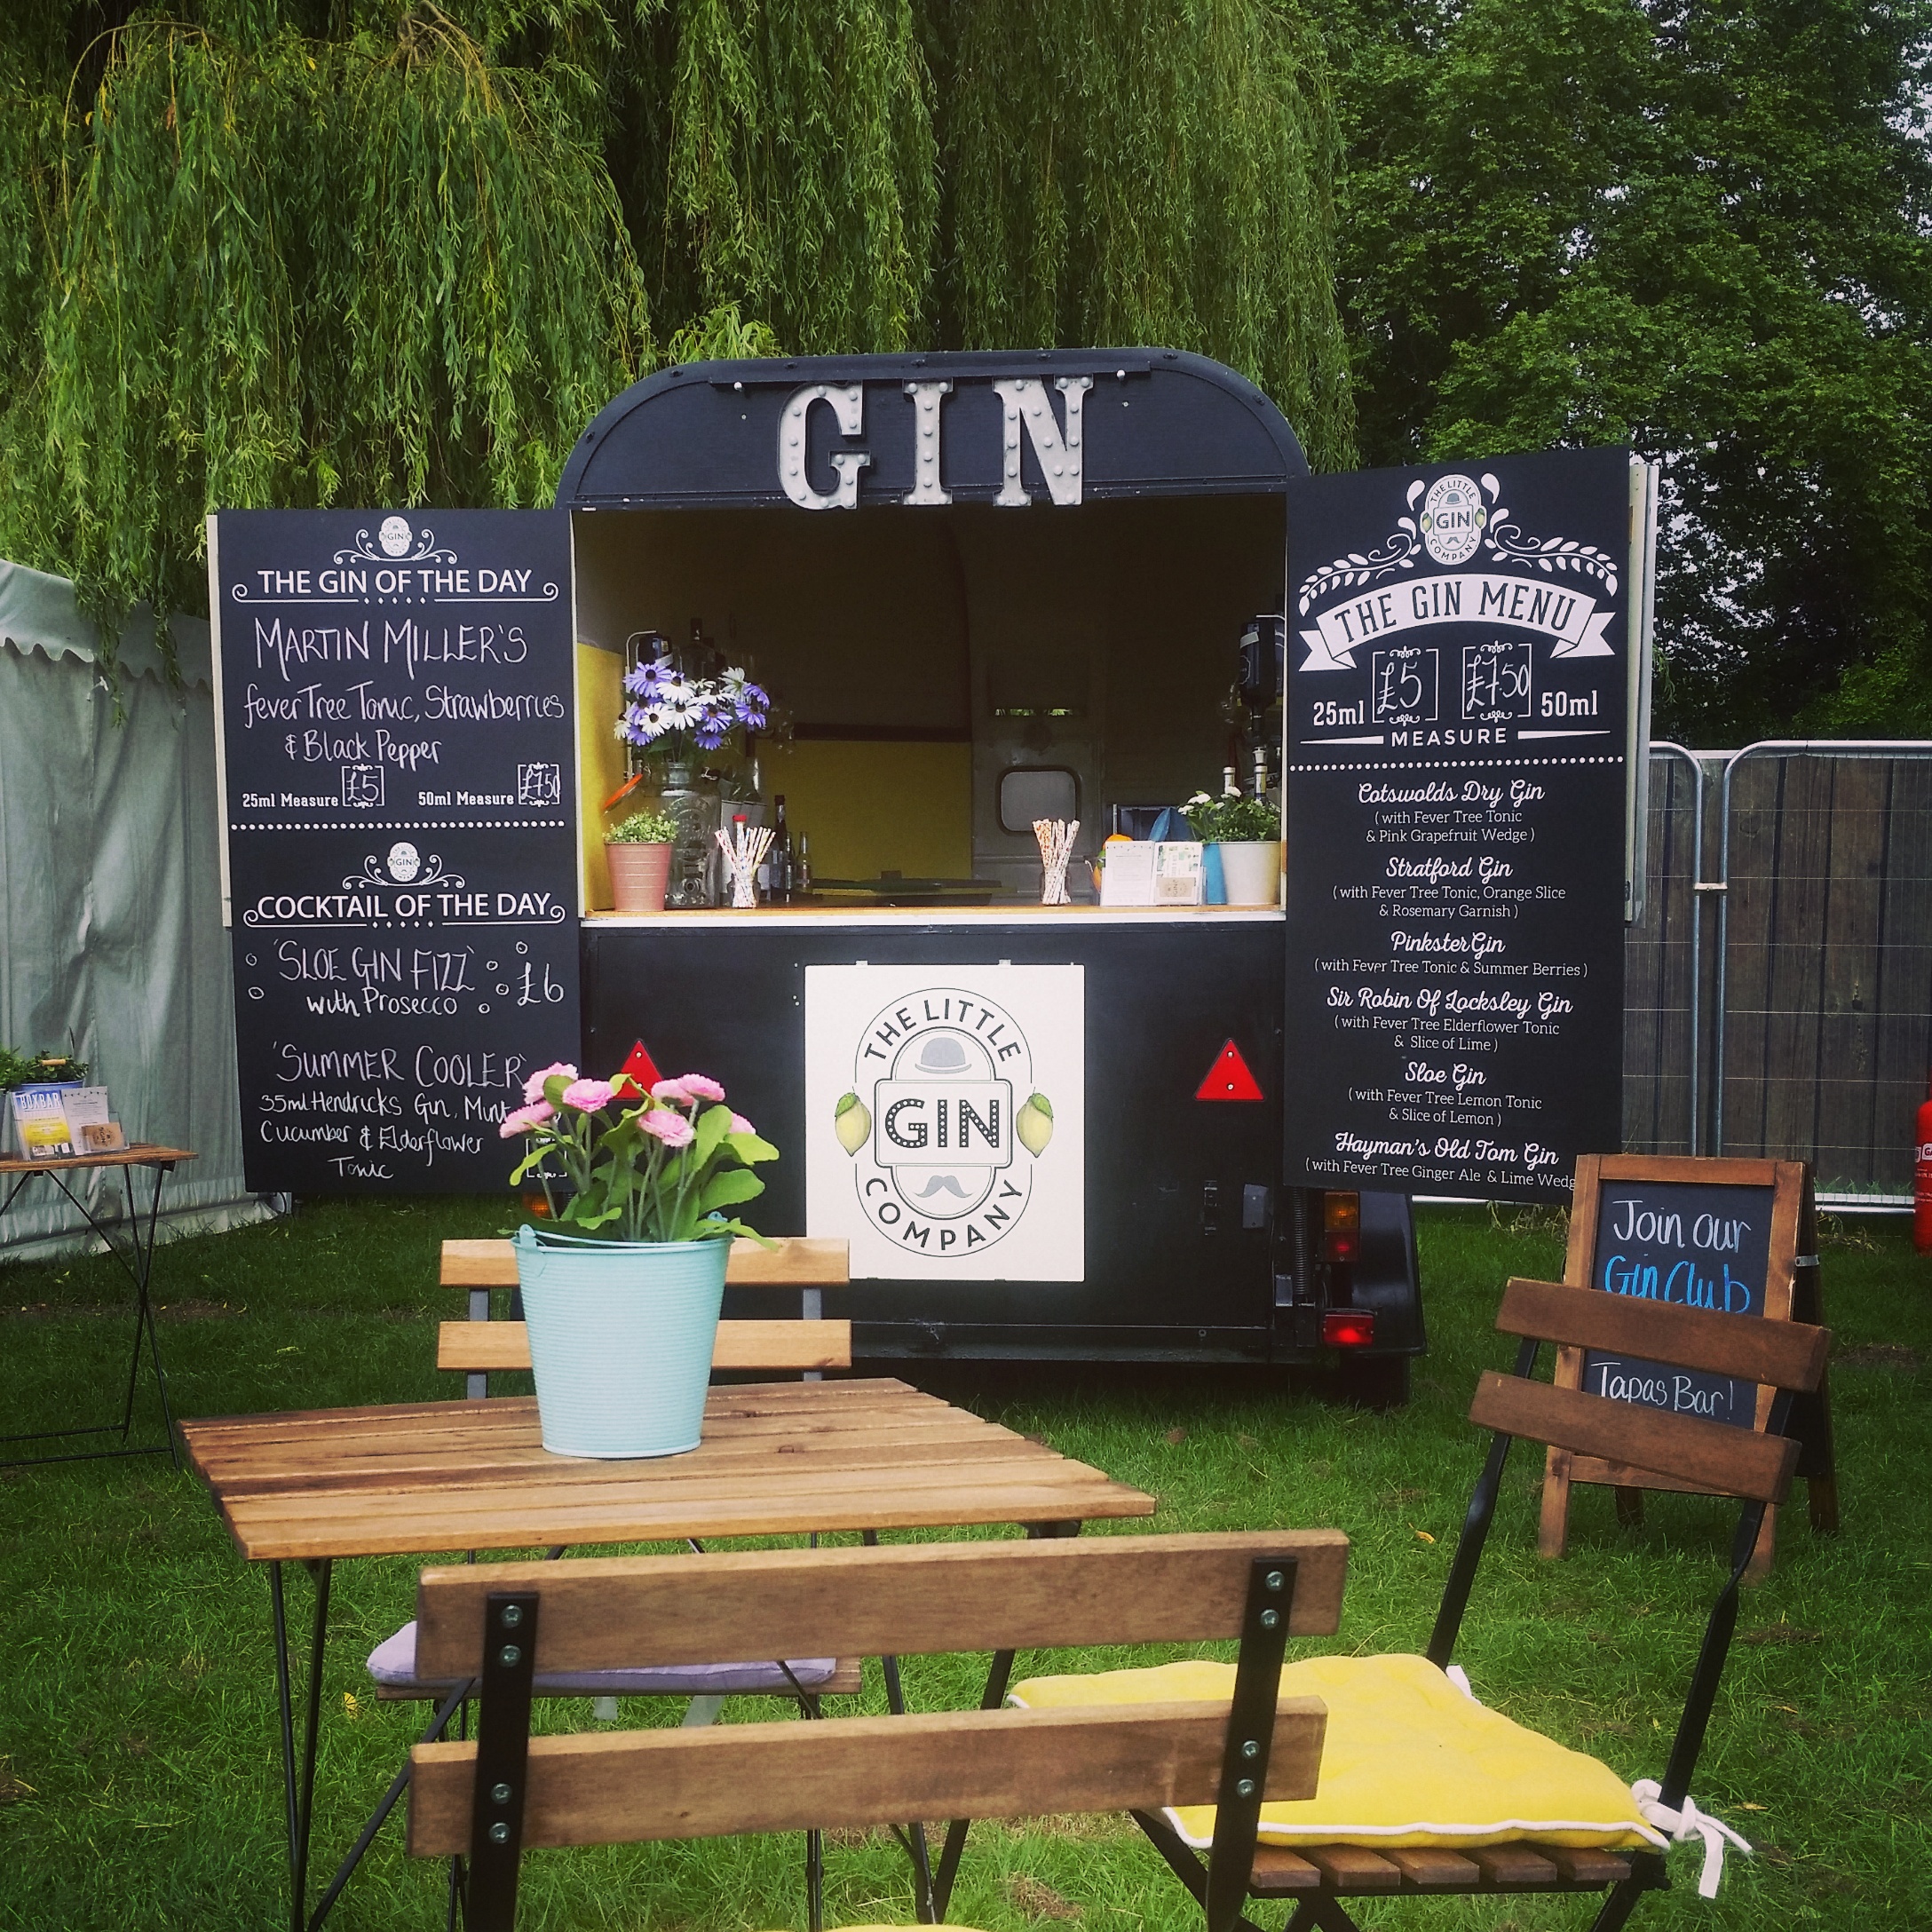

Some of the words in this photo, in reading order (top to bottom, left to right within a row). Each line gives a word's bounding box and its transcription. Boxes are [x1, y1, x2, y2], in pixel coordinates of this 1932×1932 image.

[778, 376, 1094, 510] GIN
[1430, 485, 1445, 502] THE
[1448, 480, 1476, 499] LITTLE
[1437, 511, 1469, 528] GIN
[1430, 537, 1476, 560] COMPANY
[257, 570, 310, 593] THE
[319, 570, 367, 593] GIN
[376, 570, 412, 593] OF
[417, 570, 469, 592] THE
[479, 569, 532, 592] DAY
[1334, 593, 1397, 643] THE
[1412, 581, 1461, 620] GIN
[1478, 582, 1576, 631] MENU
[1377, 661, 1421, 714] £5
[297, 684, 351, 720] Tree
[425, 685, 564, 721] Strawberries
[1313, 701, 1364, 726] 25ml
[1541, 691, 1597, 717] 50ml
[304, 730, 368, 762] Black
[376, 729, 442, 771] Pepper
[1392, 728, 1507, 747] MEASURE
[242, 793, 275, 807] 25ml
[281, 794, 338, 806] Measure
[418, 792, 451, 805] 50ml
[456, 793, 513, 805] Measure
[1358, 782, 1458, 804] Cotswolds
[1461, 780, 1503, 808] Dry
[1510, 780, 1545, 808] Gin
[1414, 812, 1450, 824] Fever
[1453, 811, 1483, 823] Tree
[1486, 810, 1522, 822] Tonic
[1366, 830, 1375, 843] &
[1379, 829, 1407, 843] Pink
[1411, 828, 1477, 845] Grapefruit
[1386, 857, 1472, 884] Stratford
[1478, 857, 1513, 884] Gin
[257, 896, 388, 919] COCKTAIL
[395, 894, 432, 917] OF
[437, 894, 488, 916] THE
[498, 892, 550, 915] DAY
[1372, 887, 1406, 899] Fever
[1410, 887, 1438, 899] Tree
[1442, 886, 1480, 900] Tonic,
[1484, 886, 1532, 901] Orange
[1536, 886, 1566, 899] Slice
[1380, 905, 1389, 917] &
[1392, 906, 1455, 919] Rosemary
[1391, 930, 1471, 954] Pinkster
[1471, 932, 1506, 960] Gin
[352, 947, 401, 986] GIN
[1353, 960, 1387, 973] Fever
[1390, 961, 1419, 973] Tree
[1422, 961, 1457, 974] Tonic
[1461, 962, 1470, 974] &
[1474, 962, 1529, 975] Summer
[517, 962, 564, 1007] £6
[306, 990, 360, 1017] with
[362, 986, 457, 1015] Prosecco
[1326, 987, 1354, 1008] Sir
[1358, 987, 1412, 1010] Robin
[1417, 988, 1441, 1016] Of
[1445, 989, 1532, 1020] Locksley
[1538, 992, 1573, 1021] Gin
[864, 1007, 916, 1059] THE
[924, 998, 1021, 1061] LITTLE
[1373, 1016, 1408, 1030] Fever
[1411, 1017, 1440, 1031] Tree
[1444, 1018, 1519, 1034] Elderflower
[1523, 1021, 1559, 1034] Tonic
[1394, 1035, 1404, 1048] &
[1411, 1035, 1438, 1049] Slice
[1442, 1036, 1455, 1049] of
[1405, 1061, 1447, 1083] Sloe
[1452, 1064, 1486, 1090] Gin
[20, 1092, 61, 1110] BOXBAR
[259, 1094, 308, 1112] 35ml
[311, 1090, 401, 1116] Hendricks
[1387, 1089, 1421, 1104] Fever
[1425, 1091, 1454, 1105] Tree
[1458, 1093, 1501, 1108] Lemon
[1505, 1095, 1542, 1110] Tonic
[885, 1098, 999, 1148] GIN
[1389, 1108, 1398, 1120] &
[1402, 1108, 1429, 1122] Slice
[1433, 1109, 1446, 1123] of
[261, 1120, 352, 1143] Cucumber
[1334, 1132, 1429, 1160] Hayman's
[1435, 1137, 1471, 1160] Old
[1475, 1139, 1517, 1162] Tom
[1524, 1143, 1559, 1170] Gin
[329, 1156, 393, 1178] Tonic
[1343, 1160, 1378, 1176] Fever
[1381, 1162, 1409, 1176] Tree
[1413, 1165, 1455, 1182] Ginger
[1458, 1168, 1480, 1182] Ale
[1487, 1170, 1498, 1184] &
[1500, 1170, 1534, 1186] Lime
[1537, 1173, 1575, 1191] Wedg
[866, 1178, 1022, 1250] COMPANY
[1613, 1200, 1684, 1247] Join
[1693, 1214, 1751, 1253] our
[1605, 1254, 1658, 1300] Gin
[1664, 1261, 1750, 1313] Club
[1591, 1362, 1667, 1405] Tapas
[1673, 1376, 1733, 1420] Bar!
